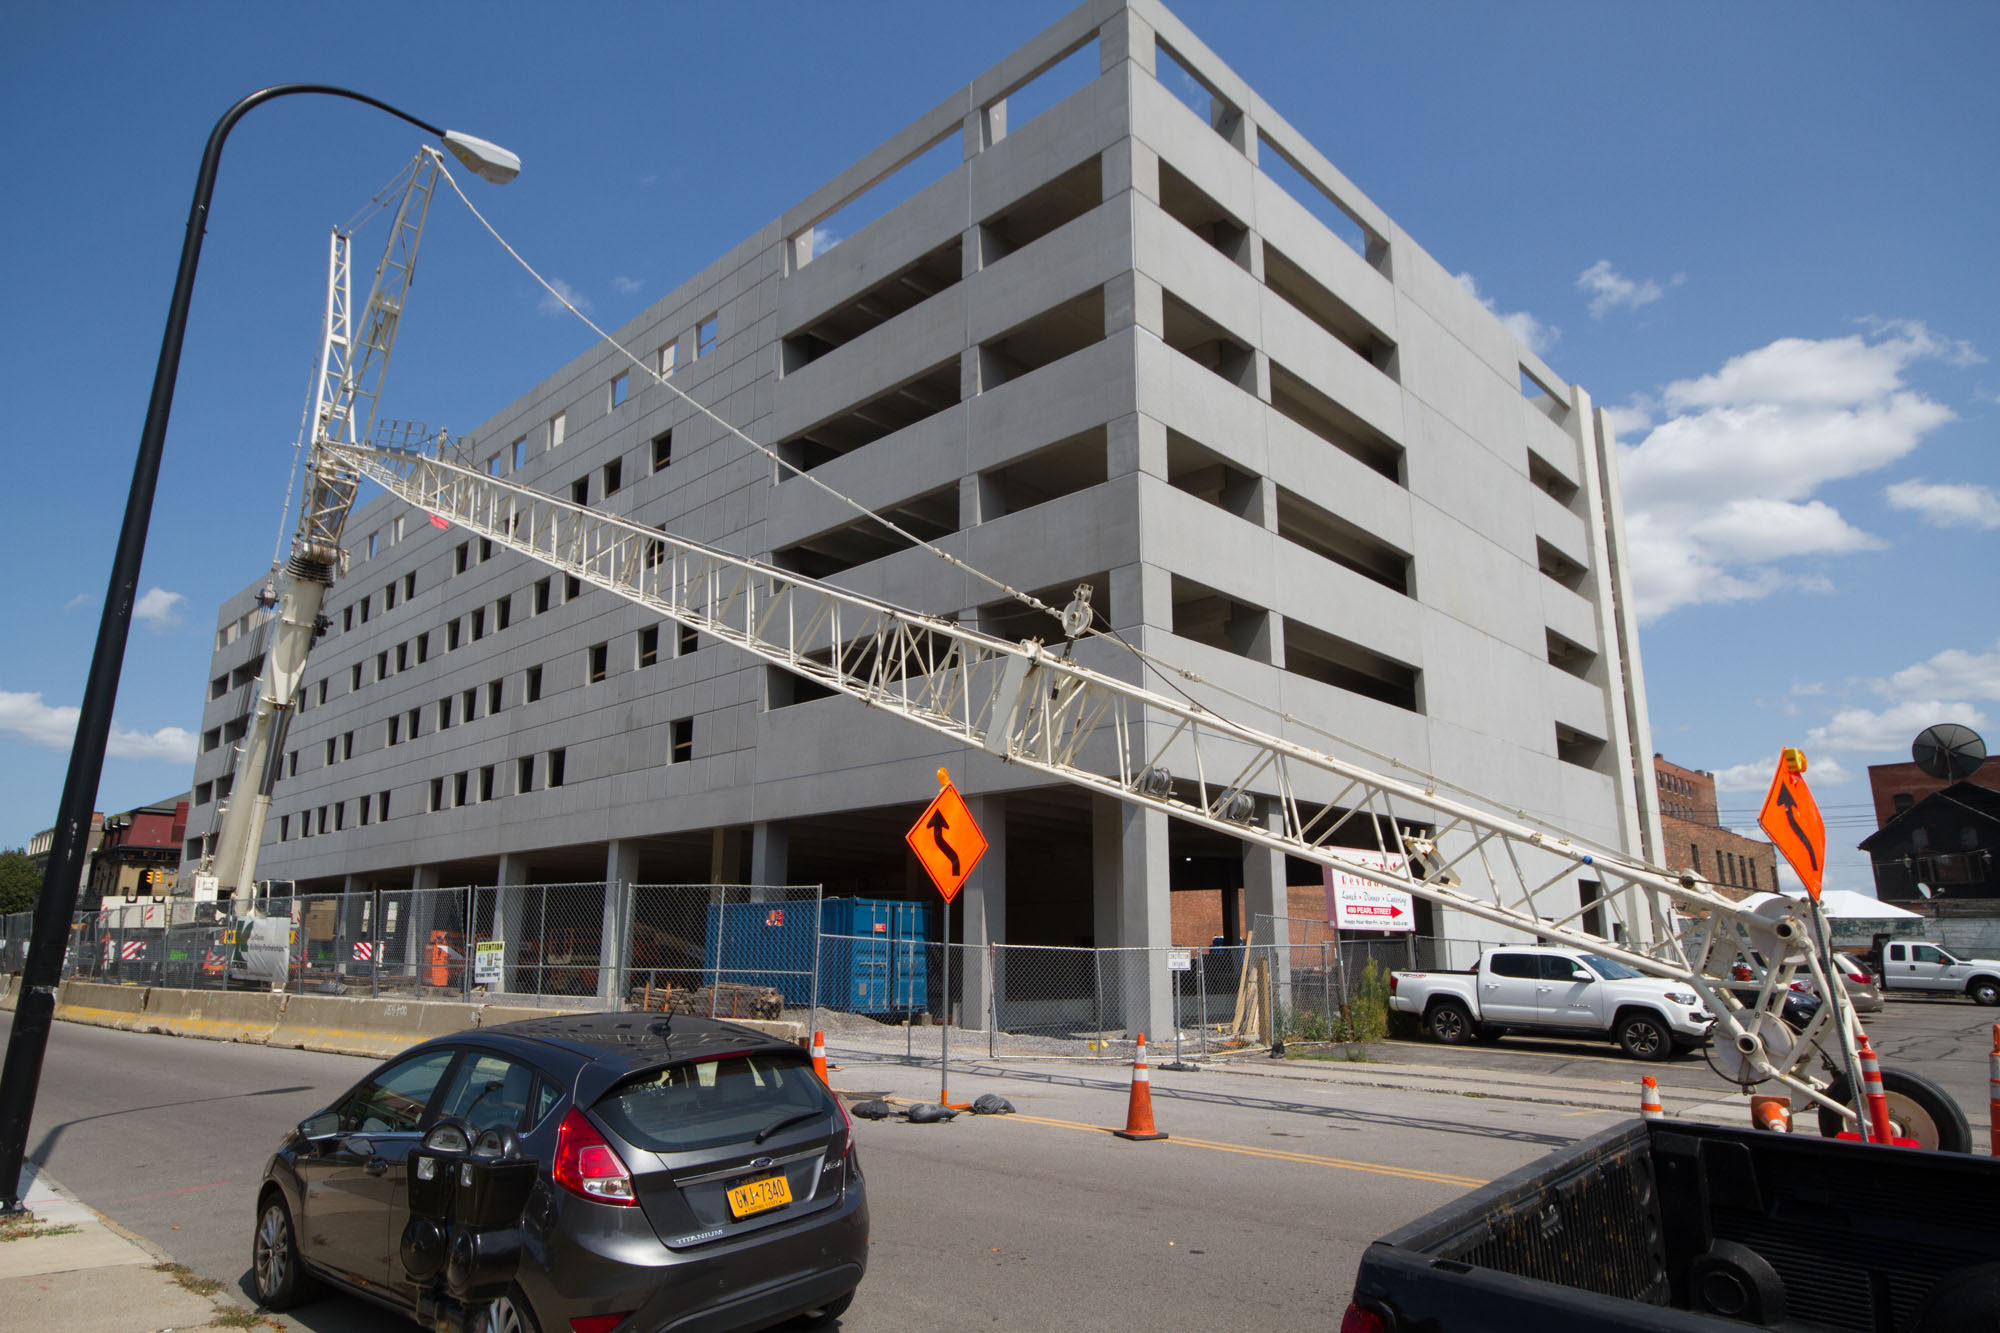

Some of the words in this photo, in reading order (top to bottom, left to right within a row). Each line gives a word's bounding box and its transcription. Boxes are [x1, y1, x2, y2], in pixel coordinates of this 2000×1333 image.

[1357, 907, 1373, 915] PEARL
[1373, 907, 1391, 916] STREET
[676, 1229, 724, 1245] TITANIUM
